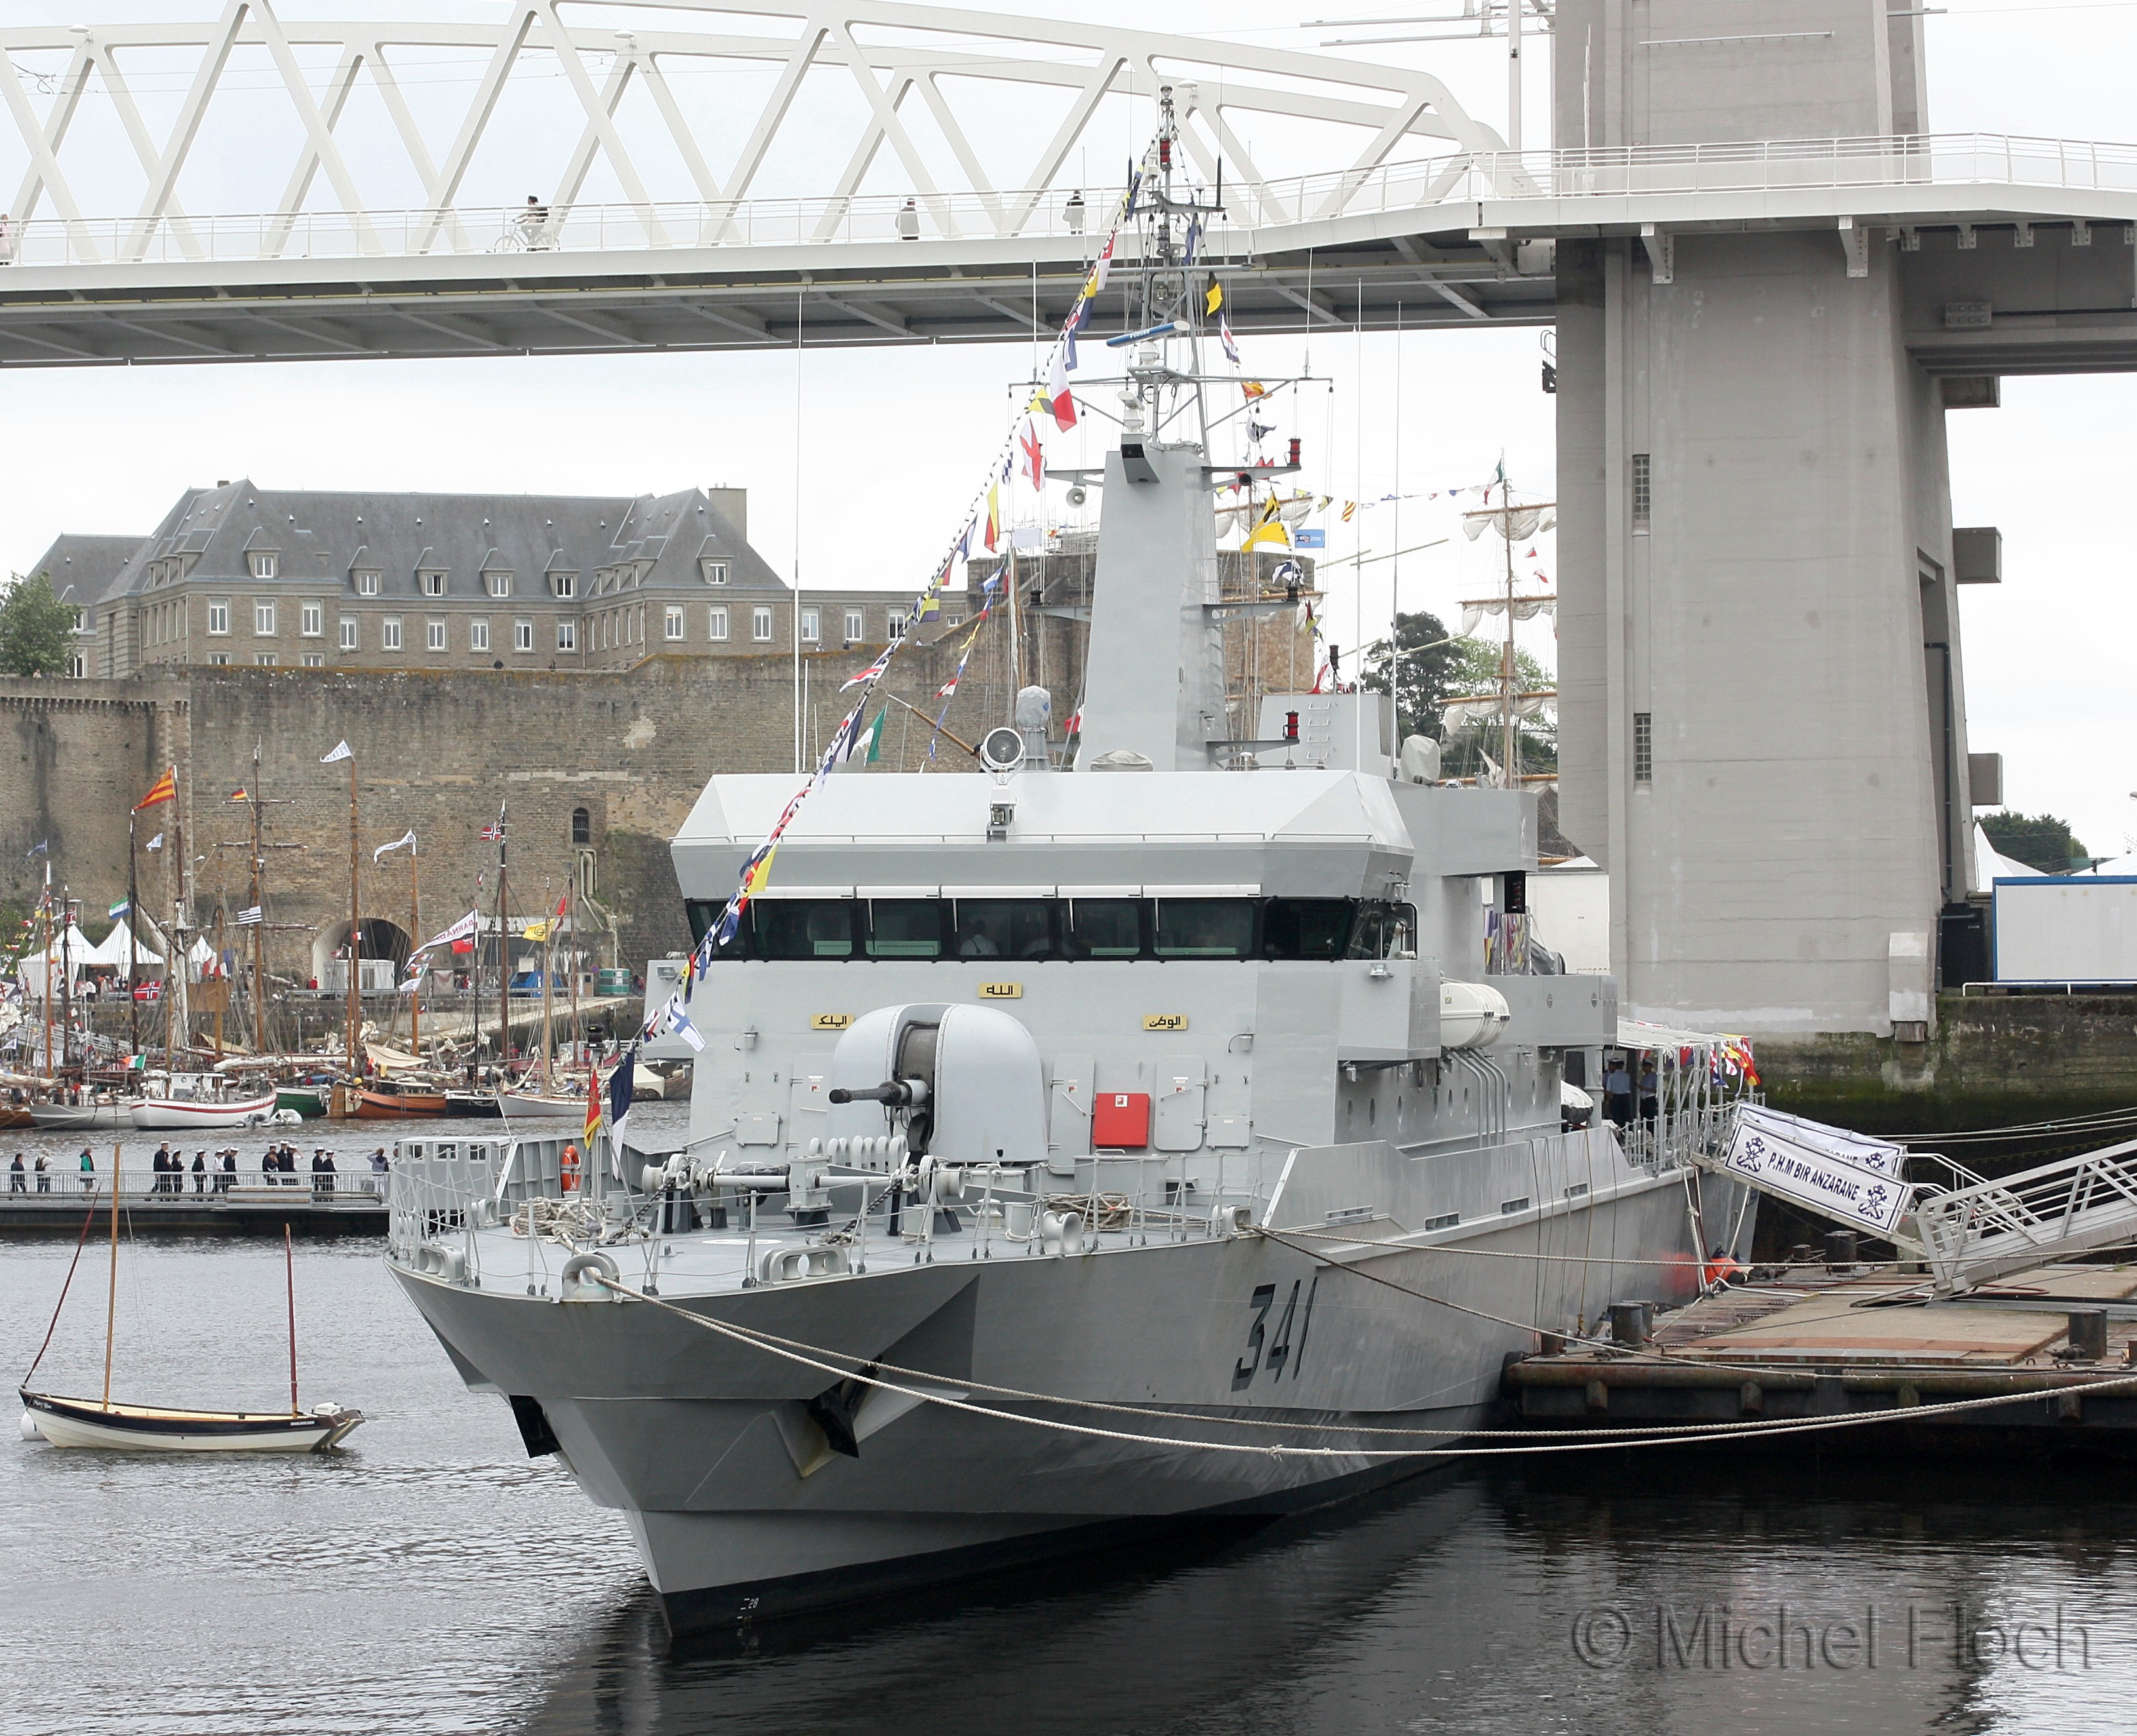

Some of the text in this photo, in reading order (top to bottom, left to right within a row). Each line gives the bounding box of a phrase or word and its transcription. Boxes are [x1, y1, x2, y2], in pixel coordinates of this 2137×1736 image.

[986, 985, 1013, 995] الله
[1149, 1016, 1180, 1029] الوطن
[1767, 1151, 1795, 1175] P.H.M
[1793, 1162, 1811, 1183] BIR
[1810, 1170, 1860, 1201] ANZARANE
[1231, 1276, 1319, 1392] 341
[748, 1597, 759, 1609] 28
